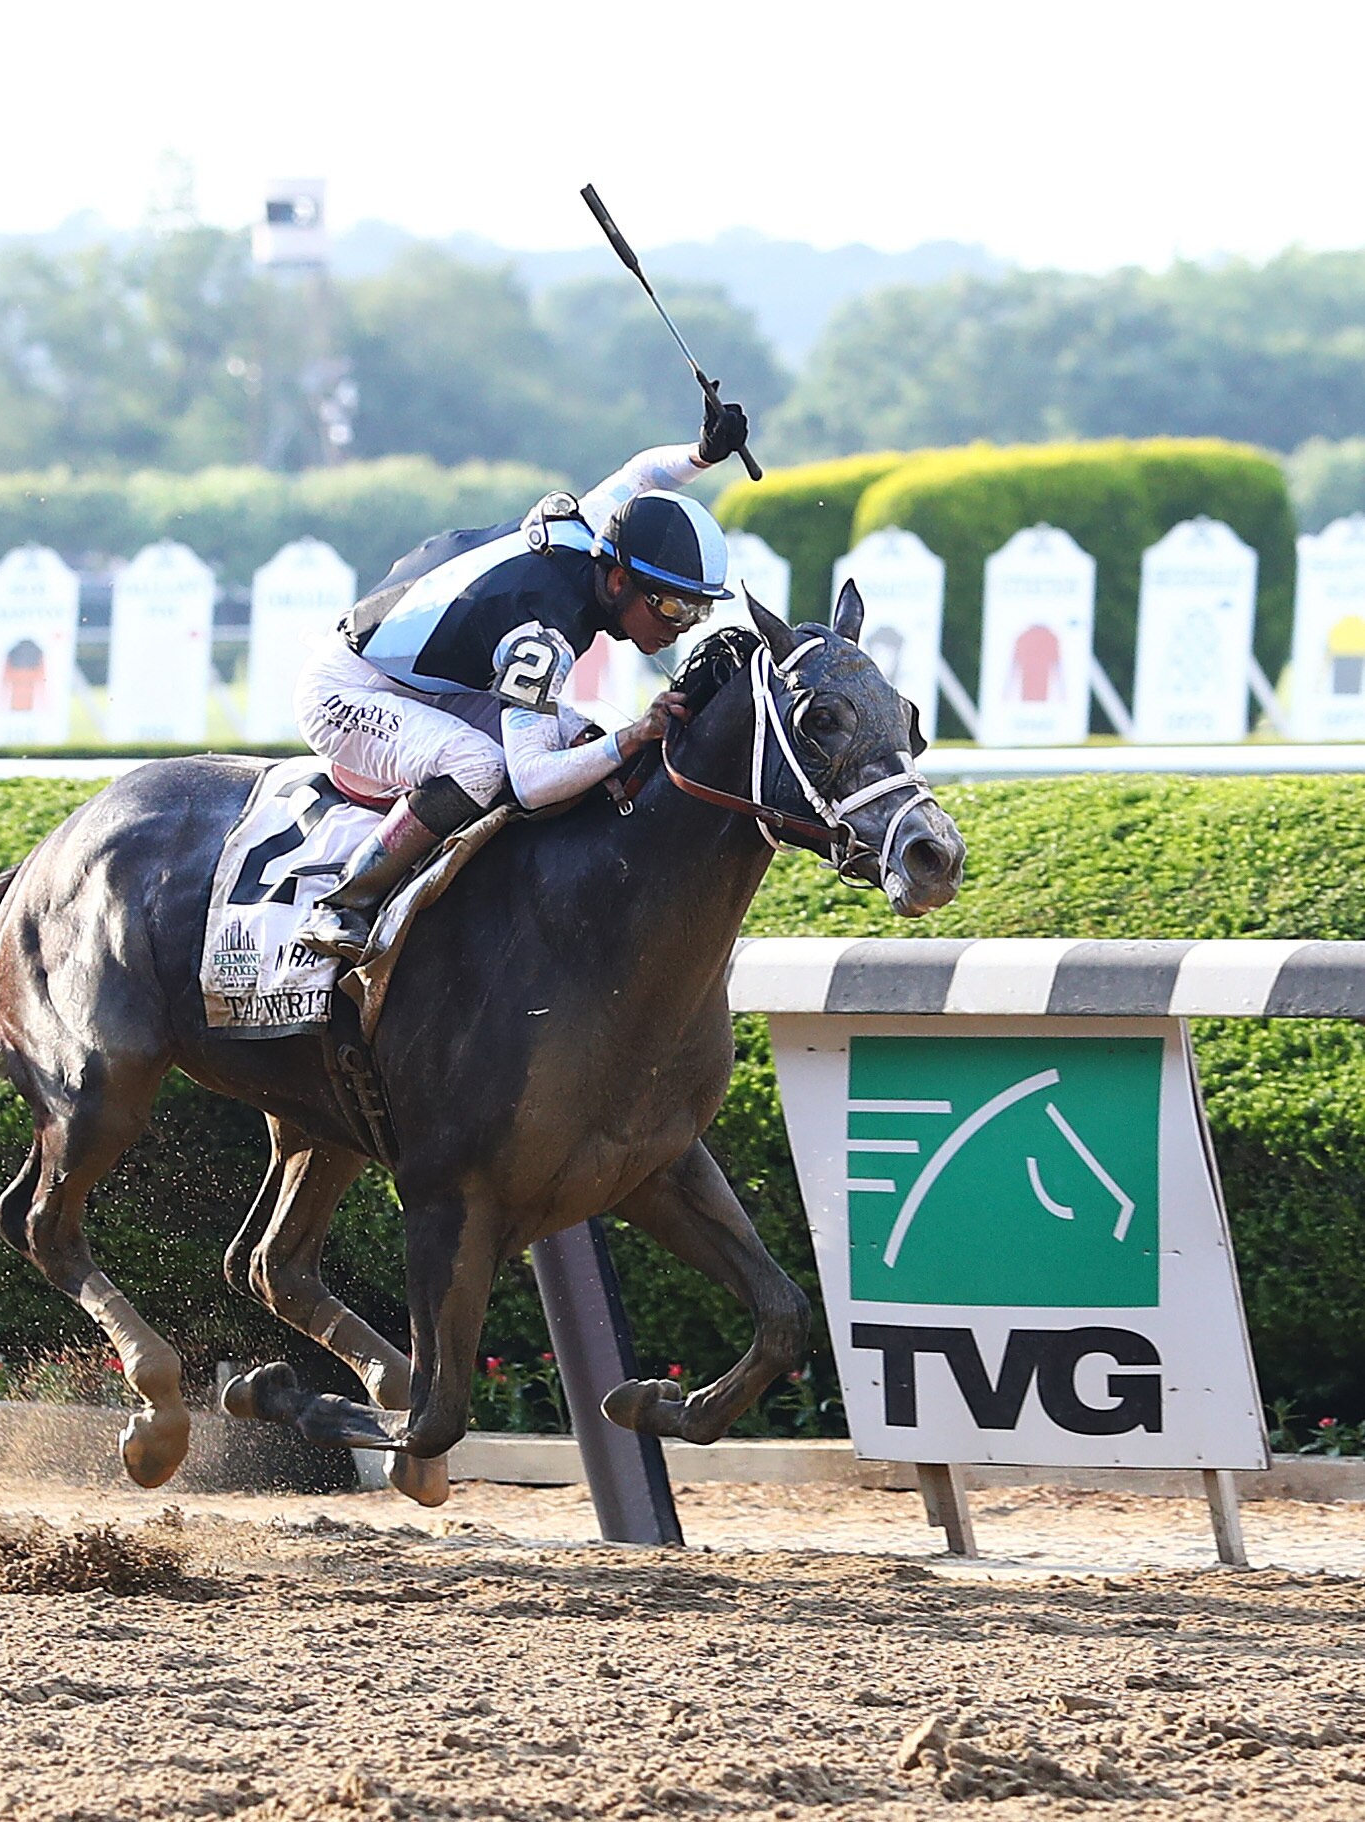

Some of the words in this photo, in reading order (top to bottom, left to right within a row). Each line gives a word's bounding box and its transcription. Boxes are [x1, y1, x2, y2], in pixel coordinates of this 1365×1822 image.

[499, 640, 554, 705] 2
[228, 772, 347, 904] 2
[213, 953, 261, 966] BELMONT
[219, 965, 259, 976] STAKES
[275, 941, 318, 971] NRA
[224, 989, 333, 1020] TAPWRIT
[851, 1322, 1164, 1435] TVG
